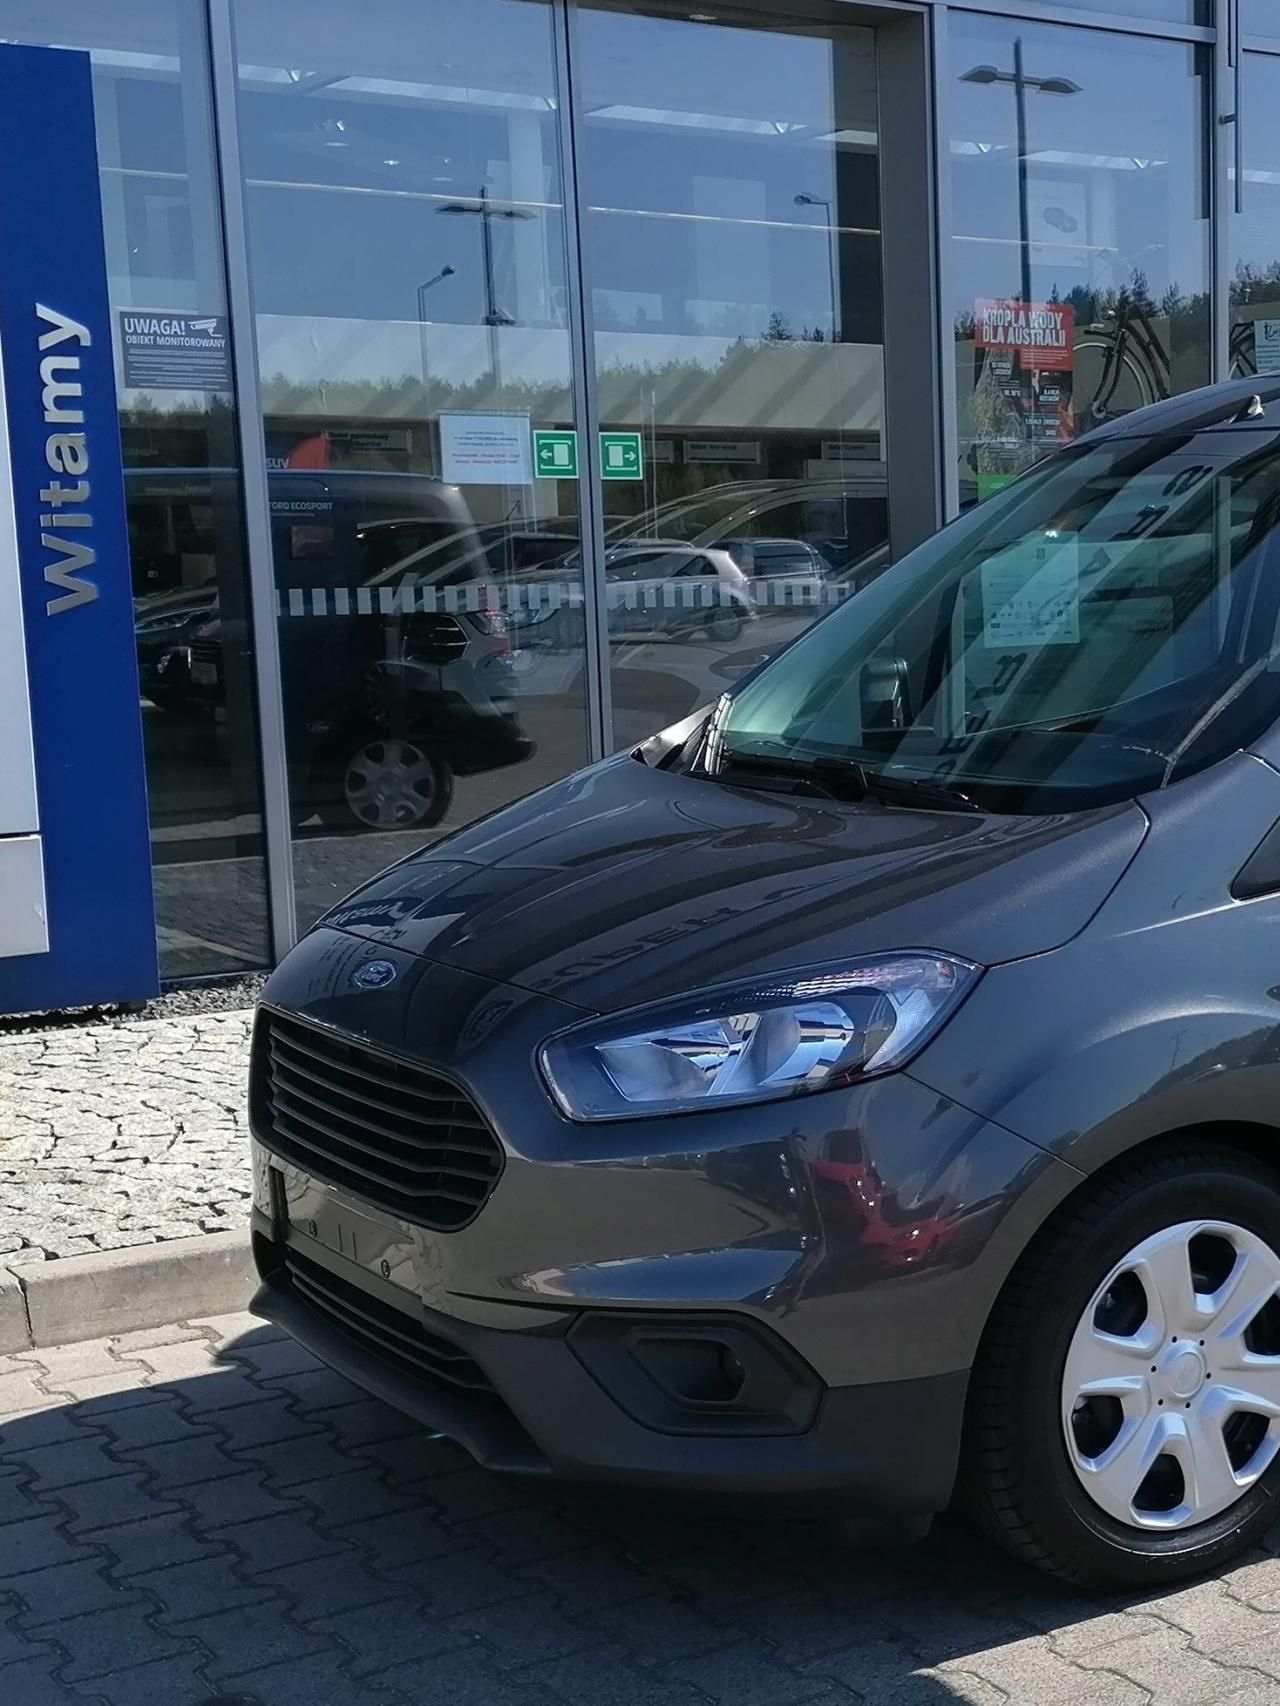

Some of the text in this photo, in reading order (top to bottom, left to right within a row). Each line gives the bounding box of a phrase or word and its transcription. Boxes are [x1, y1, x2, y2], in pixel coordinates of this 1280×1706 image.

[124, 317, 186, 336] UWAGA!
[983, 307, 1063, 330] KROPLA WODY
[125, 335, 226, 348] OBIEKT MONITOROWANY
[983, 325, 1066, 347] DLA AUSTRALII
[35, 302, 99, 617] Witamy
[291, 501, 333, 511] ECOSPORT
